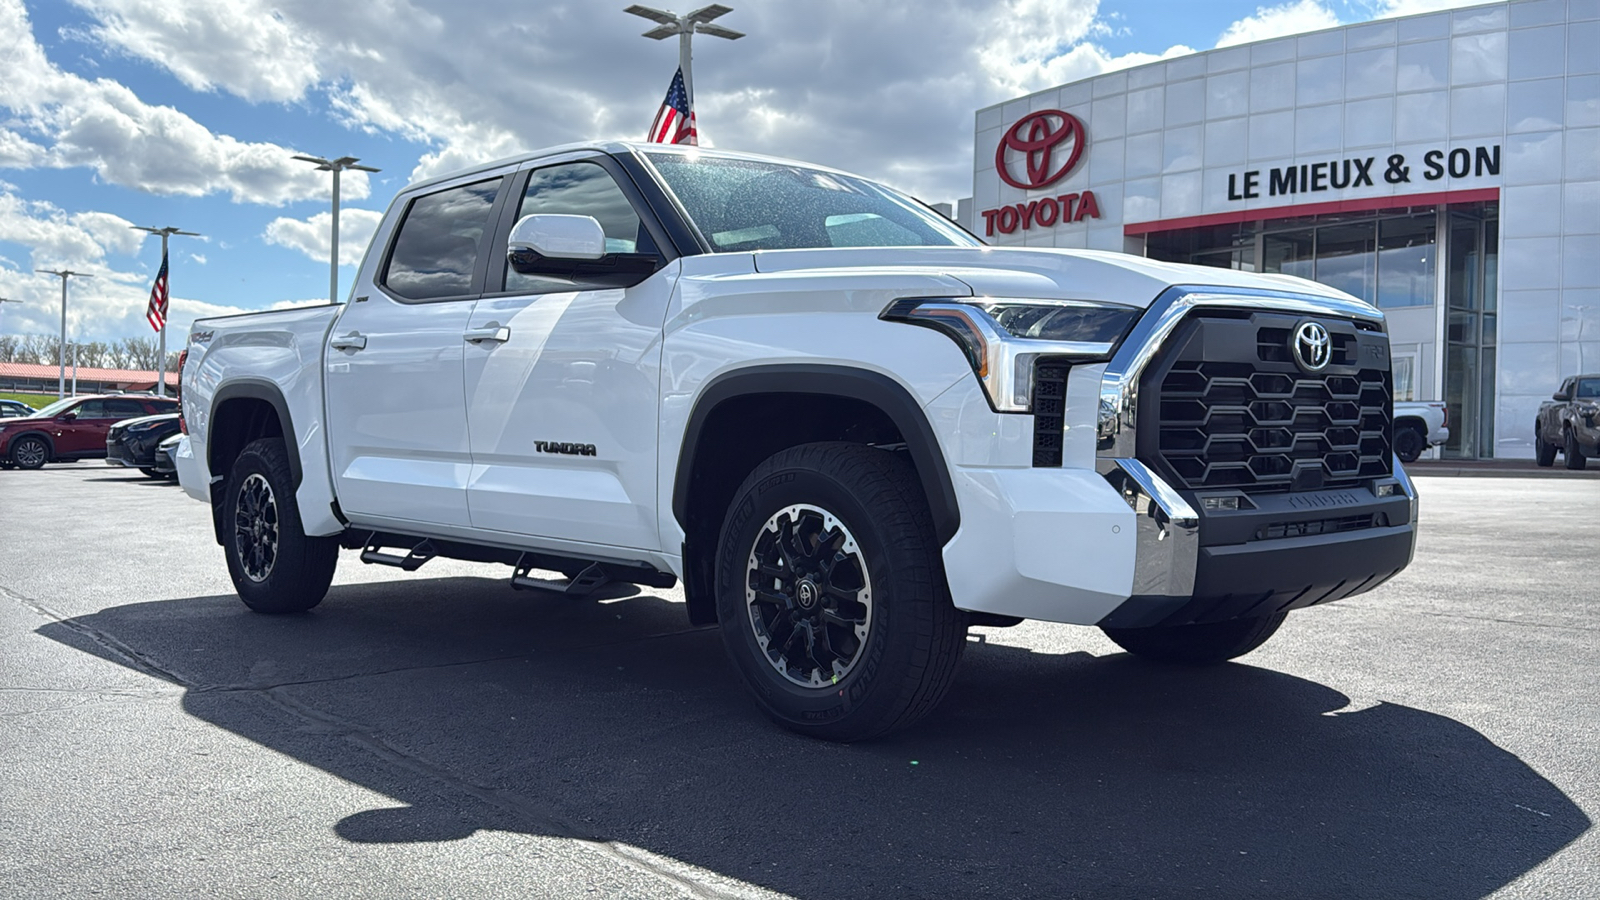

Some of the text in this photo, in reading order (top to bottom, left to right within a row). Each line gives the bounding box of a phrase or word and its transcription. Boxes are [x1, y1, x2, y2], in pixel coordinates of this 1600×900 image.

[1228, 145, 1501, 201] LE MIEUX & SON
[982, 190, 1101, 237] TOYOTA
[1362, 344, 1384, 359] TRD
[533, 440, 597, 457] TUNDRA
